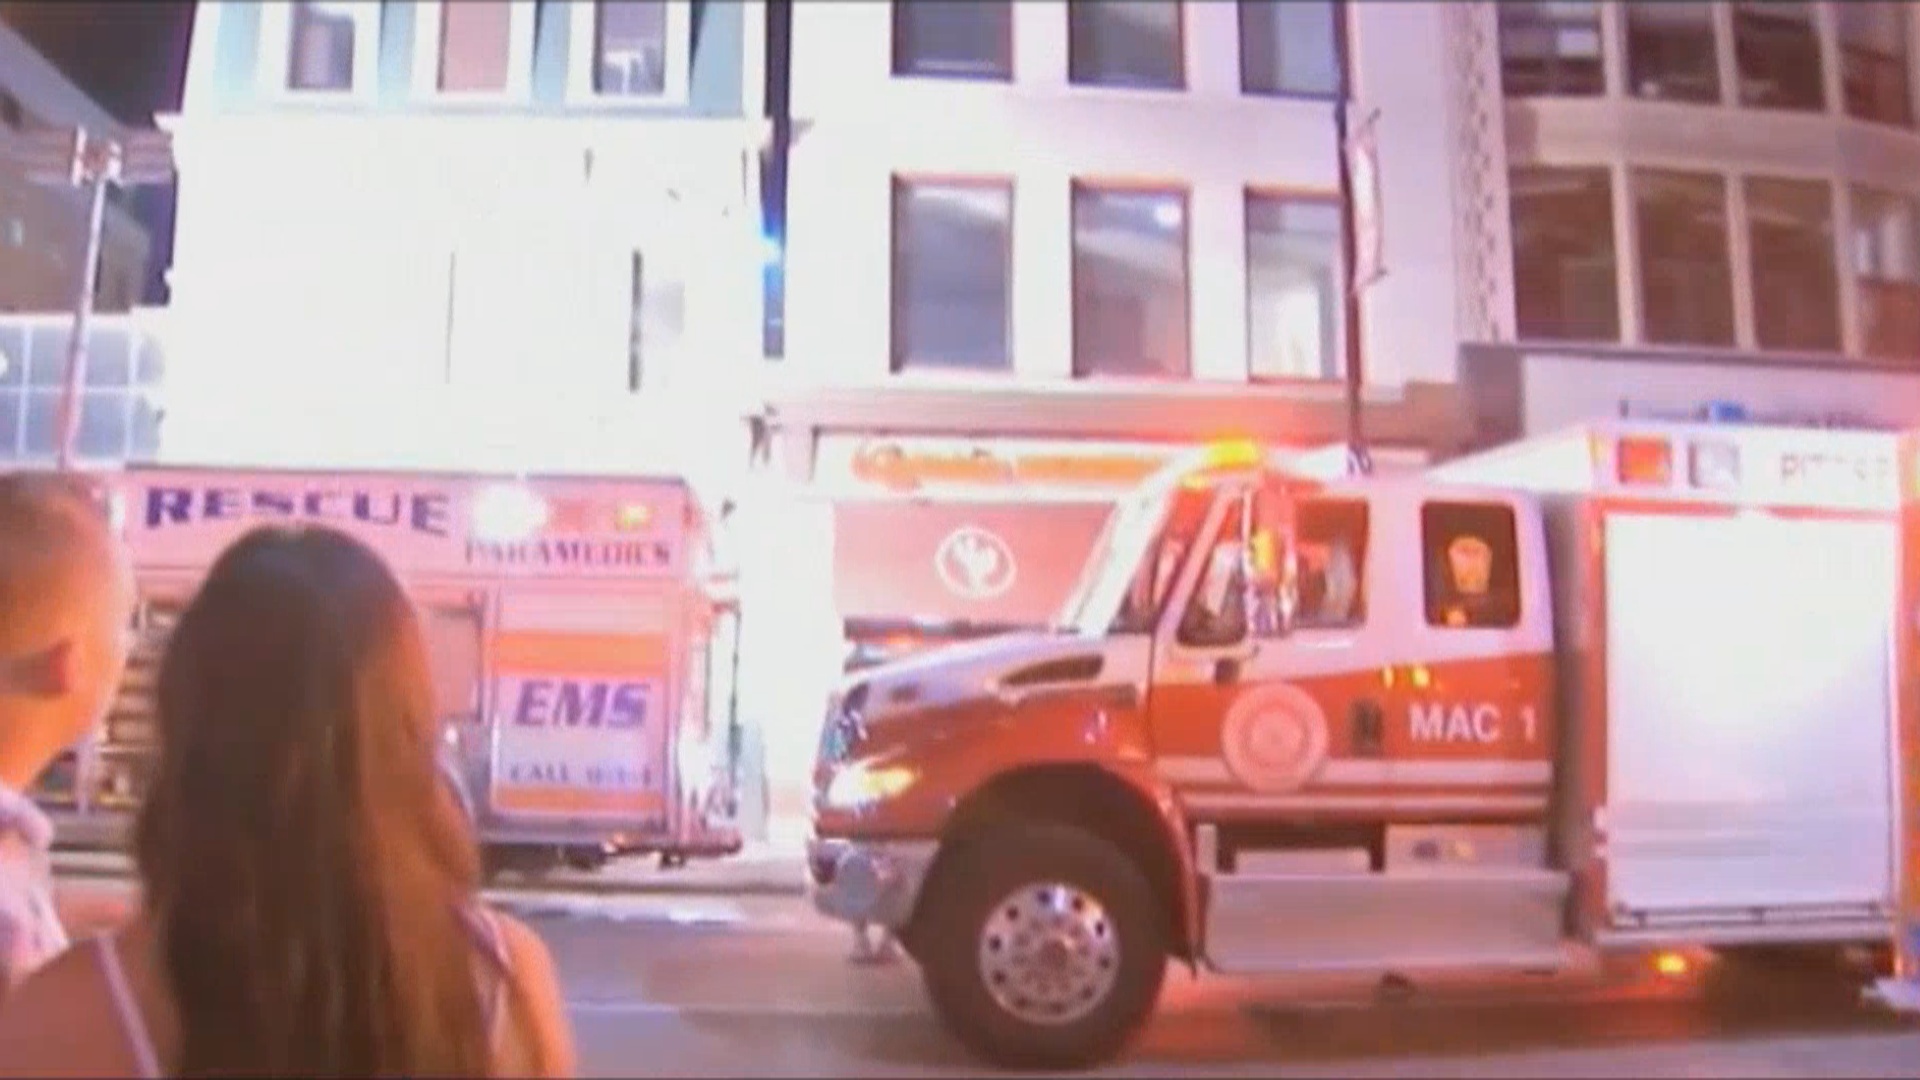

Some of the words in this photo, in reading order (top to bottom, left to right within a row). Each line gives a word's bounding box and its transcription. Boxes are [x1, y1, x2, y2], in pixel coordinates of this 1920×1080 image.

[146, 487, 449, 536] RESCUE
[465, 540, 670, 564] PARAMEDICS
[515, 681, 649, 728] EMS
[1410, 702, 1500, 742] MAC
[1519, 705, 1536, 742] 1
